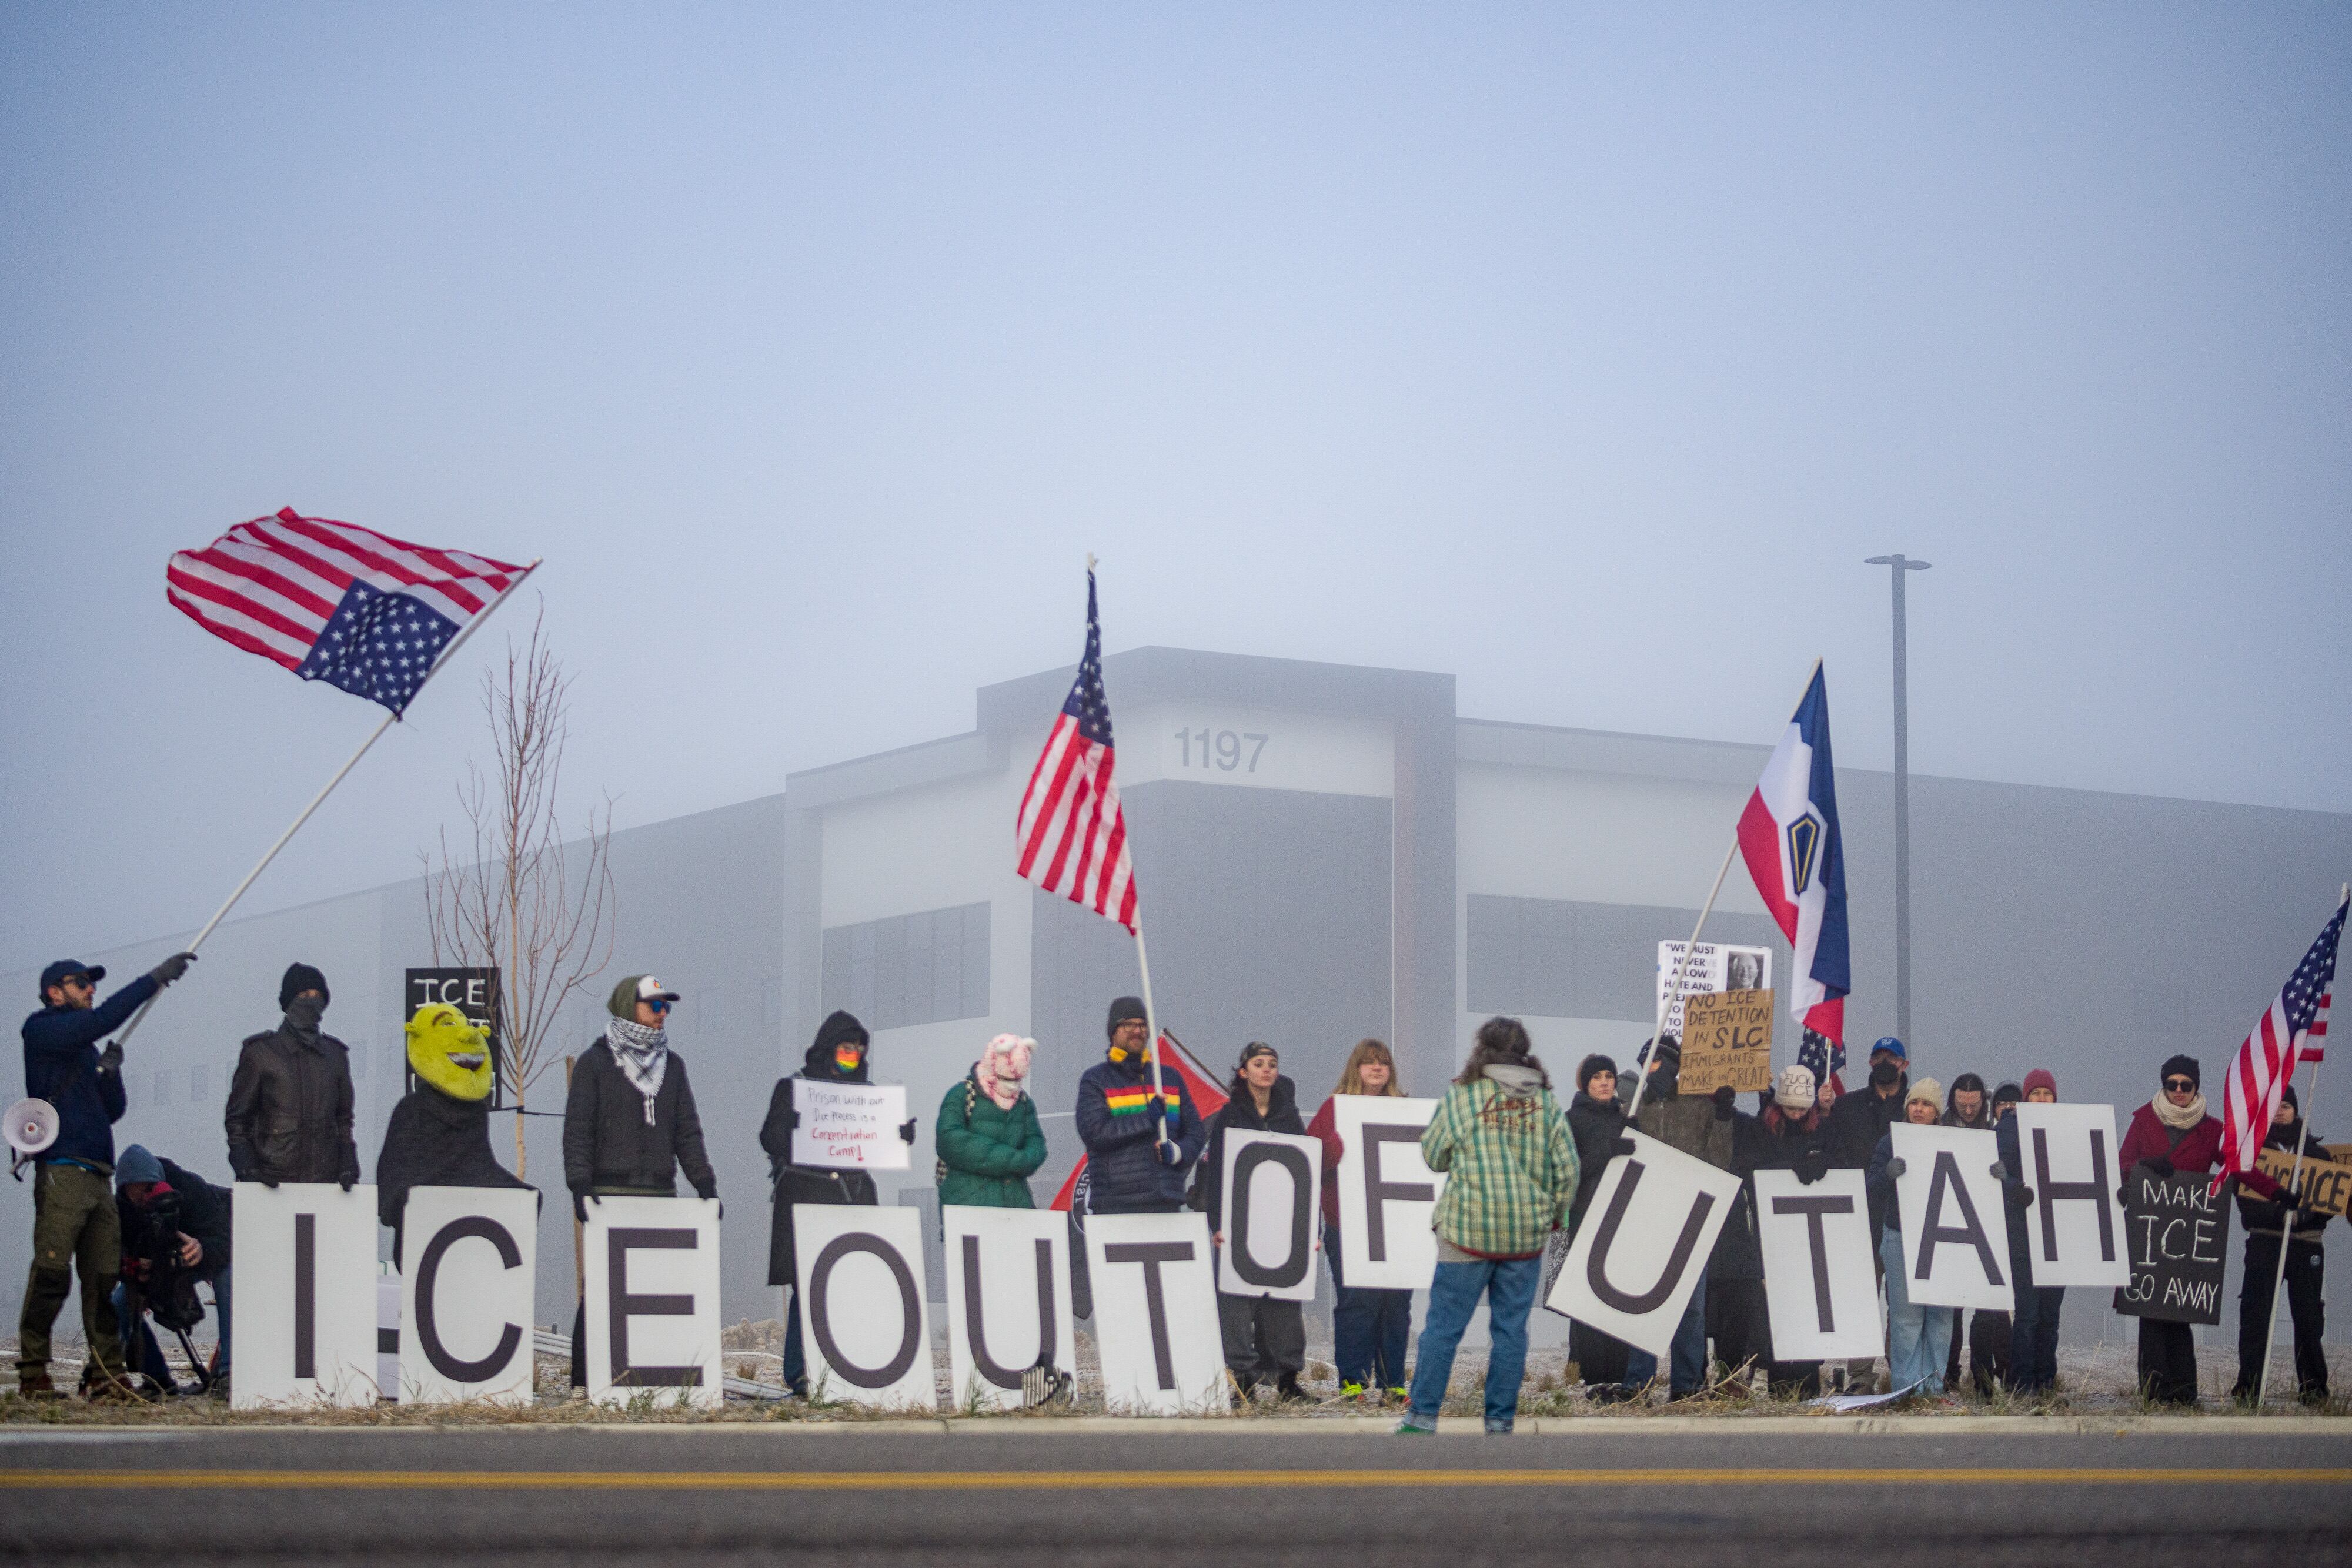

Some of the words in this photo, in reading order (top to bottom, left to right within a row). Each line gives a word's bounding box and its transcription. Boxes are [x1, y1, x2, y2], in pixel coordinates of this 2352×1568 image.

[1175, 726, 1269, 773] 1197
[1674, 957, 1705, 966] NVER
[1672, 968, 1708, 978] ALOW
[413, 978, 486, 1008] ICE
[1665, 979, 1689, 989] HTE
[1692, 982, 1713, 991] AND
[1688, 993, 1716, 1009] NO
[1726, 990, 1757, 1004] ICE
[1689, 1006, 1769, 1025] DETENTION
[1693, 1031, 1709, 1046] IN
[1682, 1052, 1755, 1068] IMMIGRANTS
[1682, 1070, 1715, 1088] MAKE
[1728, 1066, 1766, 1086] GREAT
[1784, 1073, 1812, 1085] FUCK
[808, 1087, 841, 1105] Prison
[1782, 1084, 1812, 1096] ICE
[814, 1108, 828, 1122] Due
[812, 1127, 877, 1141] Concentration
[2142, 1178, 2217, 1213] MAKE
[2300, 1166, 2351, 1213] ICE
[2136, 1215, 2219, 1266] ICE
[2124, 1273, 2155, 1301] GO
[2163, 1277, 2219, 1315] AWAY
